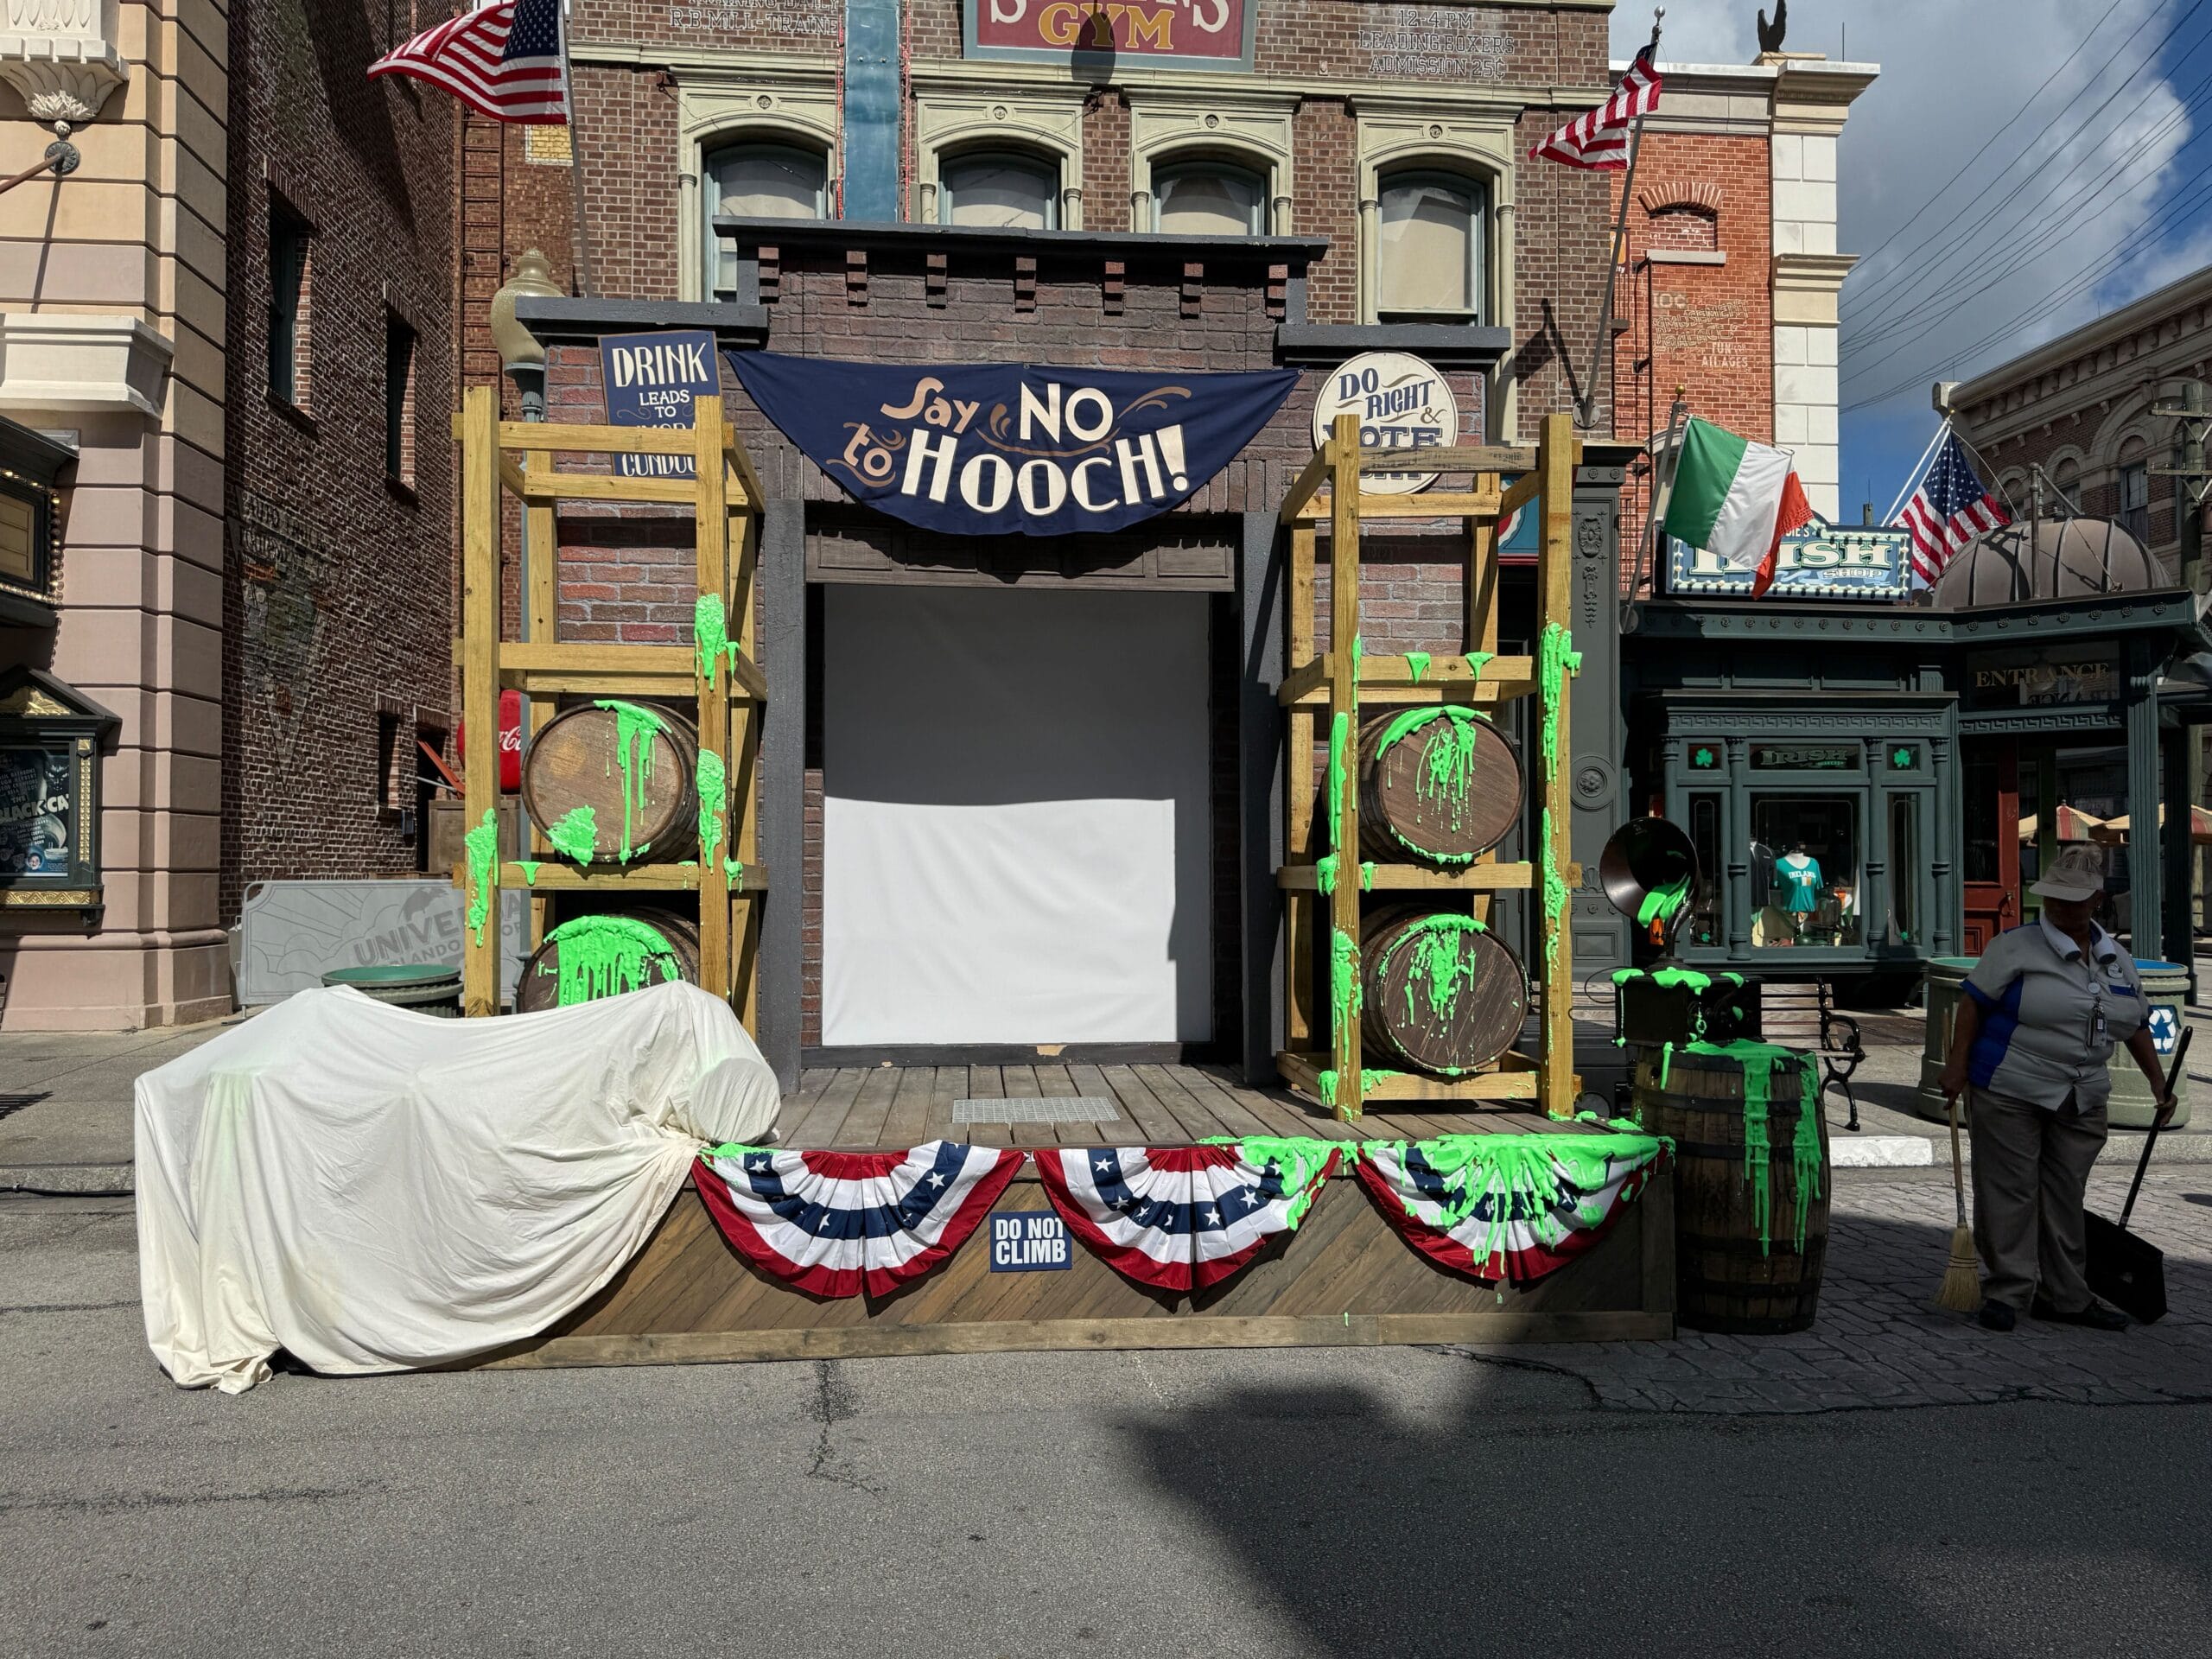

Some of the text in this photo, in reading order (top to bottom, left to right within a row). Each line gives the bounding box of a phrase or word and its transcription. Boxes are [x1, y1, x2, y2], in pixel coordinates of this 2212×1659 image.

[1038, 3, 1175, 49] GYM
[1446, 12, 1474, 29] PM
[1358, 30, 1516, 54] LEADING BOXERS
[1369, 54, 1505, 79] ADMISSION 25¢
[1711, 342, 1732, 354] FUN
[612, 342, 709, 387] DRINK
[1721, 356, 1748, 367] AGES
[1338, 368, 1379, 401] DO
[639, 389, 690, 406] LEADS
[1364, 379, 1436, 421] RIGHT
[654, 406, 677, 418] TO
[880, 376, 1114, 443] Say NO
[1420, 406, 1447, 424] &
[1322, 424, 1443, 447] OTE
[621, 454, 696, 477] CONDU
[843, 423, 1190, 516] to HOOCH!
[1690, 541, 1893, 576] IISH
[1822, 569, 1883, 579] SHOP
[1976, 663, 2109, 688] ENTRANCE
[1760, 750, 1848, 766] IRISH
[48, 793, 69, 813] CA
[1788, 870, 1817, 879] IRELAND
[389, 939, 461, 965] LANDO
[995, 1217, 1064, 1240] DO NOT
[995, 1239, 1066, 1265] CLIMB
